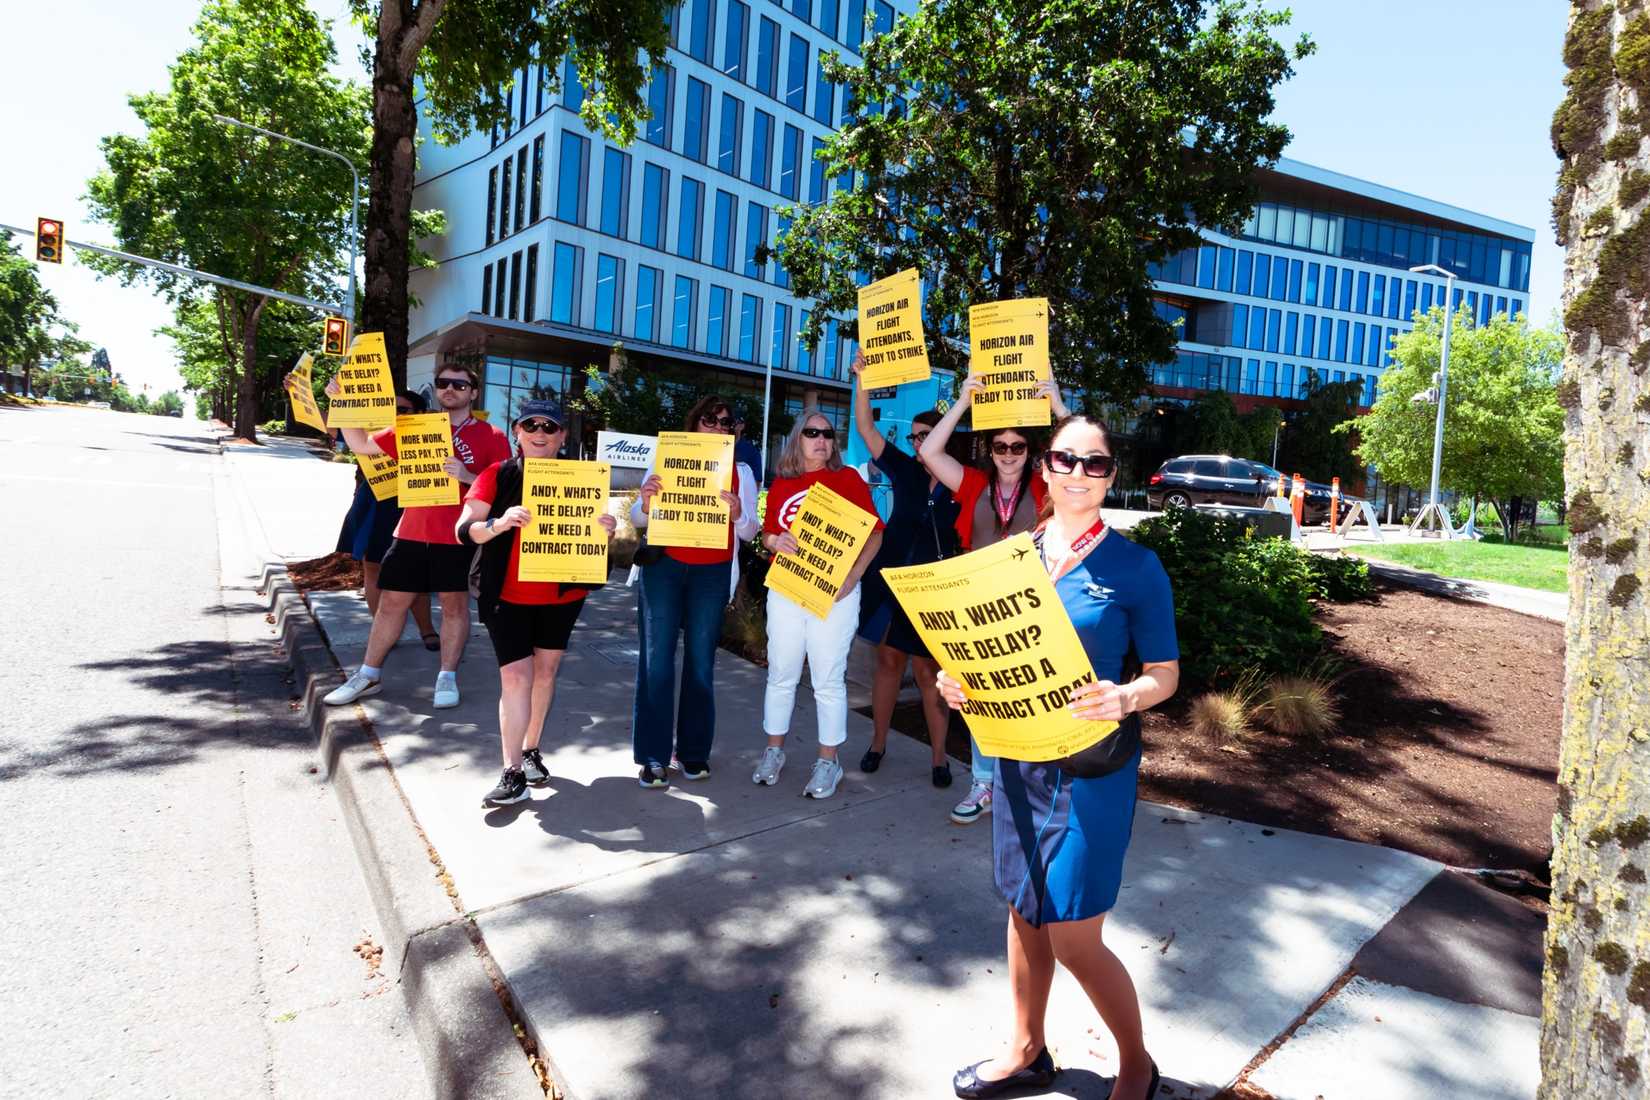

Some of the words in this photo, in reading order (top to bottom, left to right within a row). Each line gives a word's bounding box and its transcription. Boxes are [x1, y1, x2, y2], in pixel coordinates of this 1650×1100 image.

[866, 302, 895, 319] HORIZON
[896, 298, 909, 310] AIR
[876, 316, 900, 331] FLIGHT
[866, 330, 915, 349] ATTENDANTS,
[980, 335, 1016, 351] HORIZON
[1019, 334, 1034, 346] AIR
[355, 353, 382, 364] WHAT'S
[886, 350, 896, 362] TO
[898, 345, 924, 360] STRIKE
[993, 353, 1023, 366] FLIGHT
[340, 370, 353, 380] THE
[354, 368, 379, 379] DELAY?
[344, 384, 355, 394] WE
[357, 383, 375, 393] NEED
[376, 383, 382, 392] A
[331, 398, 370, 408] CONTRACT
[372, 397, 395, 407] TODAY
[974, 390, 1001, 405] READY
[1003, 389, 1013, 401] TO
[1016, 388, 1048, 400] STRI
[401, 435, 420, 445] MORE
[605, 440, 651, 455] Alaska
[400, 450, 417, 460] LESS
[418, 449, 435, 459] PAY,
[435, 447, 449, 458] IT'S
[400, 465, 413, 474] THE
[414, 463, 441, 474] ALASKA
[664, 457, 702, 471] HORIZON
[368, 470, 398, 485] CONTRAC
[407, 478, 431, 489] GROUP
[433, 477, 450, 488] WAY
[676, 475, 707, 488] FLIGHT
[531, 485, 560, 499] ANDY,
[563, 486, 601, 500] WHAT'S
[661, 492, 719, 508] ATTENDANTS,
[537, 504, 554, 516] THE
[557, 505, 595, 518] DELAY?
[683, 510, 694, 522] TO
[696, 512, 727, 525] STRIKE
[539, 523, 554, 535] WE
[557, 524, 582, 536] NEED
[584, 525, 591, 536] A
[801, 511, 823, 532] ANDY,
[824, 523, 856, 547] WHAT'S
[521, 541, 573, 555] CONTRACT
[575, 543, 607, 556] TODAY
[798, 528, 813, 545] THE
[813, 537, 844, 560] DELAY?
[807, 552, 828, 571] NEED
[826, 564, 834, 575] A
[775, 554, 815, 584] CONTRACT
[813, 575, 839, 597] TODAY
[920, 578, 970, 592] ATTENDANTS
[918, 610, 968, 631] ANDY,
[965, 587, 1041, 627] WHAT'S
[942, 642, 975, 661] THE
[973, 624, 1042, 660] DELAY?
[961, 671, 991, 691] WE
[989, 664, 1038, 690] NEED
[1040, 657, 1057, 678] A
[961, 698, 1036, 719] CONTRACT
